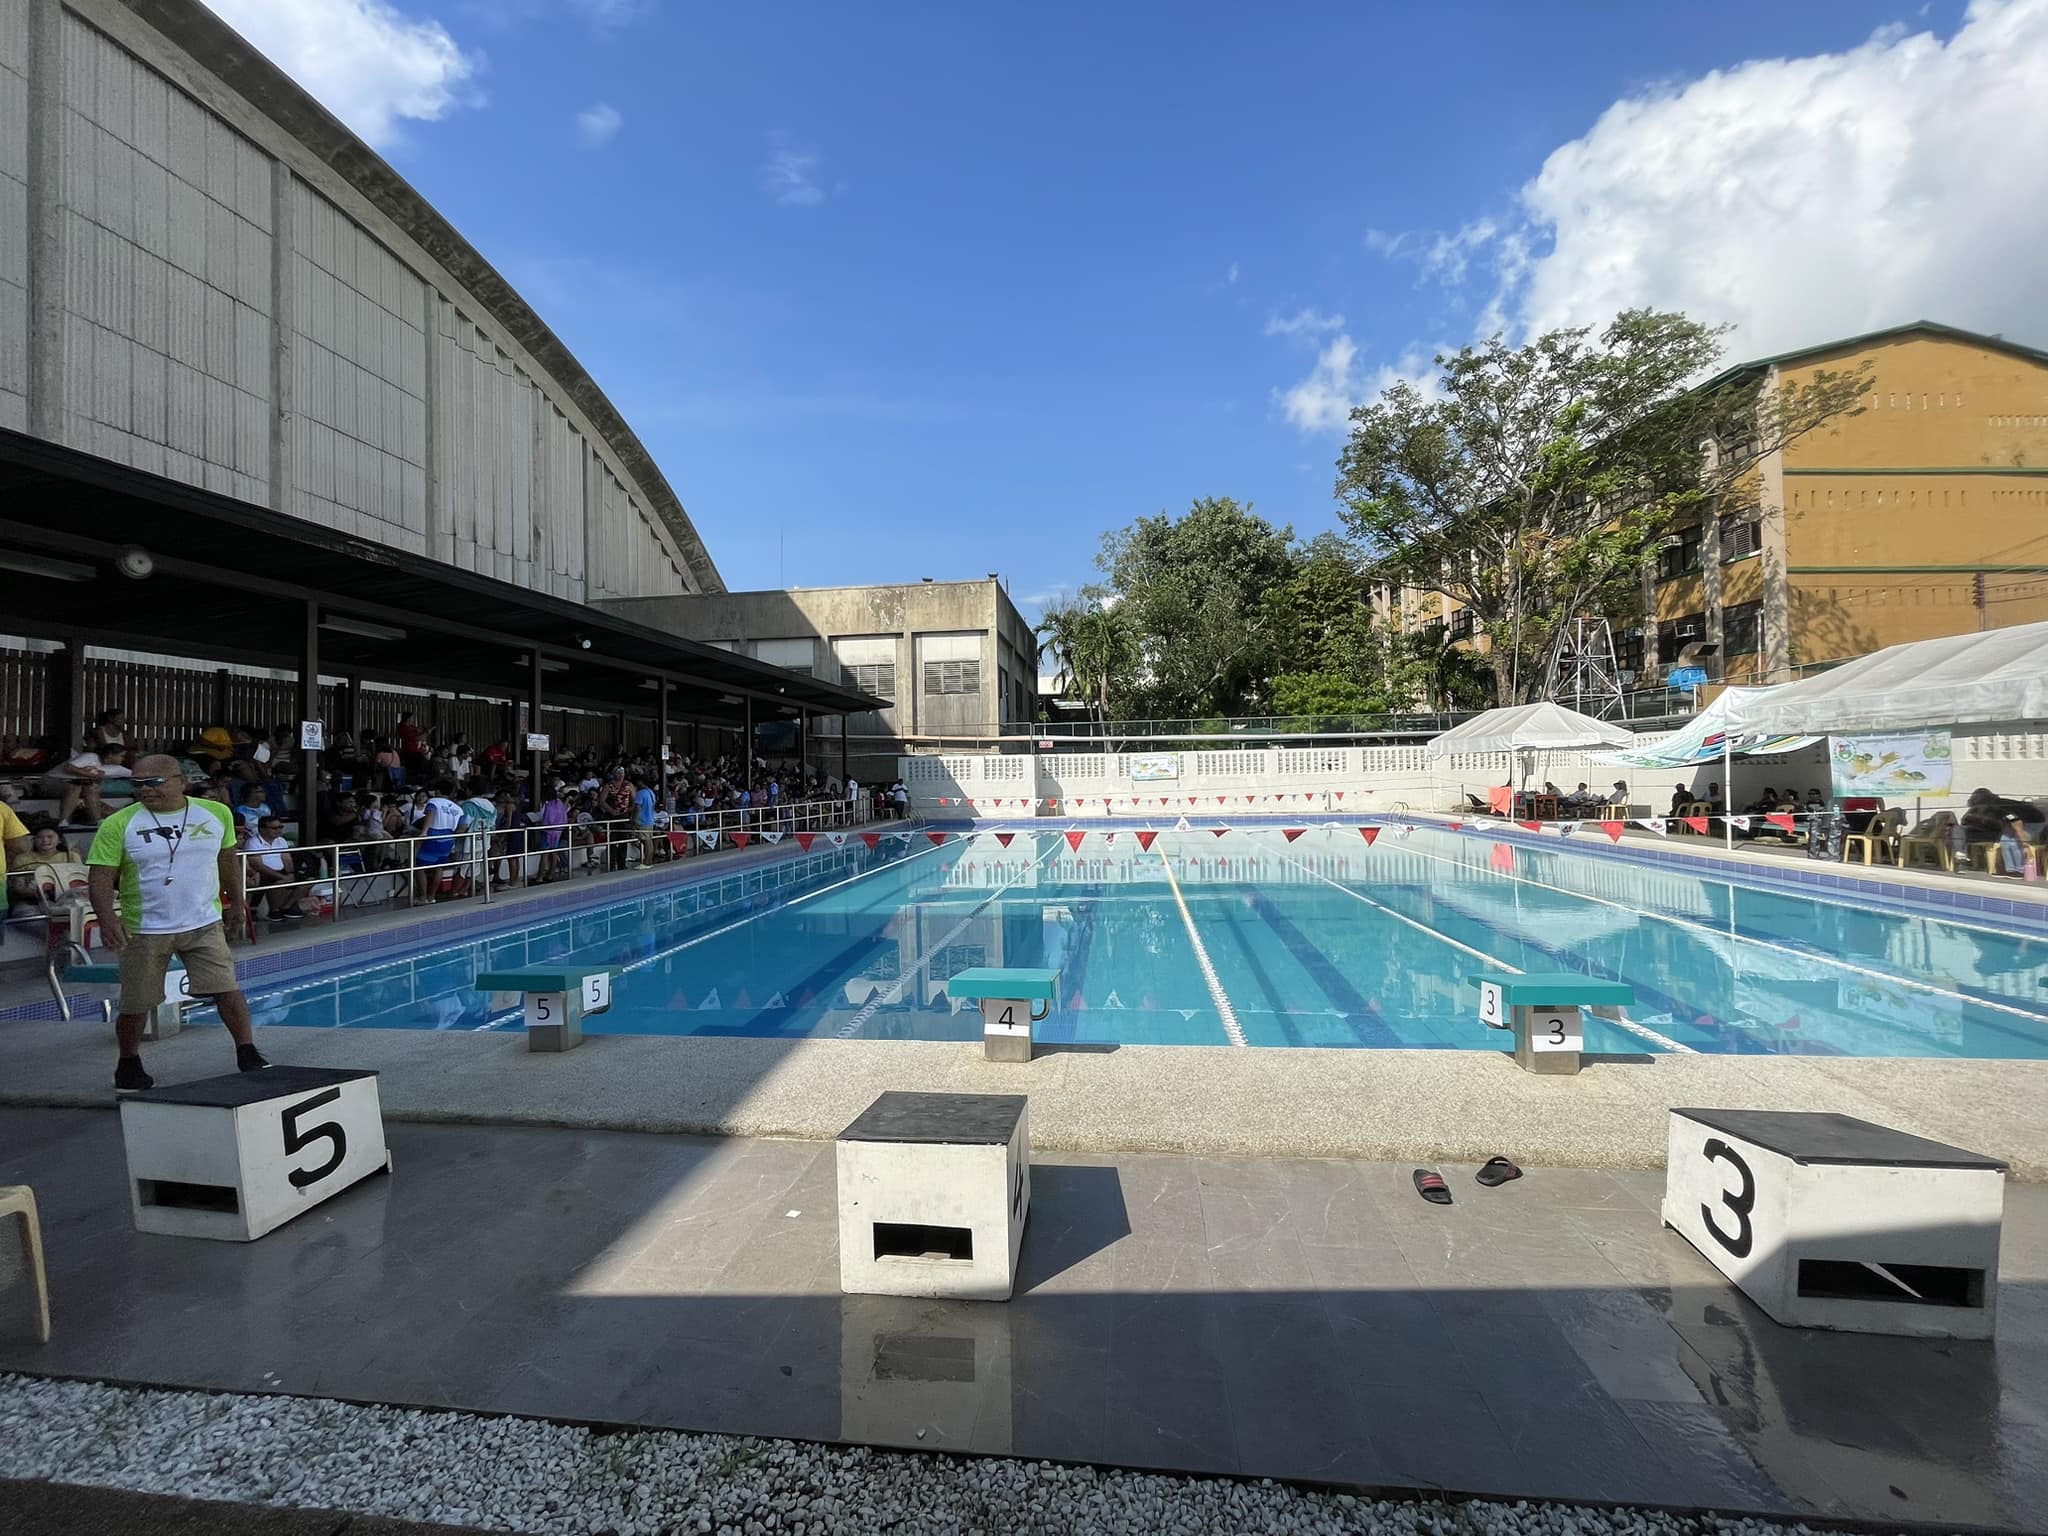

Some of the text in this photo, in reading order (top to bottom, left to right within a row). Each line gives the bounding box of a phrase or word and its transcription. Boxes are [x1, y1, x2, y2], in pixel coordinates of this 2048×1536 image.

[591, 979, 601, 1003] 5
[1486, 989, 1495, 1016] 3
[537, 998, 550, 1020] 5
[998, 1006, 1016, 1030] 4
[1548, 1019, 1566, 1045] 3
[281, 1086, 347, 1188] 5
[1700, 1138, 1756, 1259] 3
